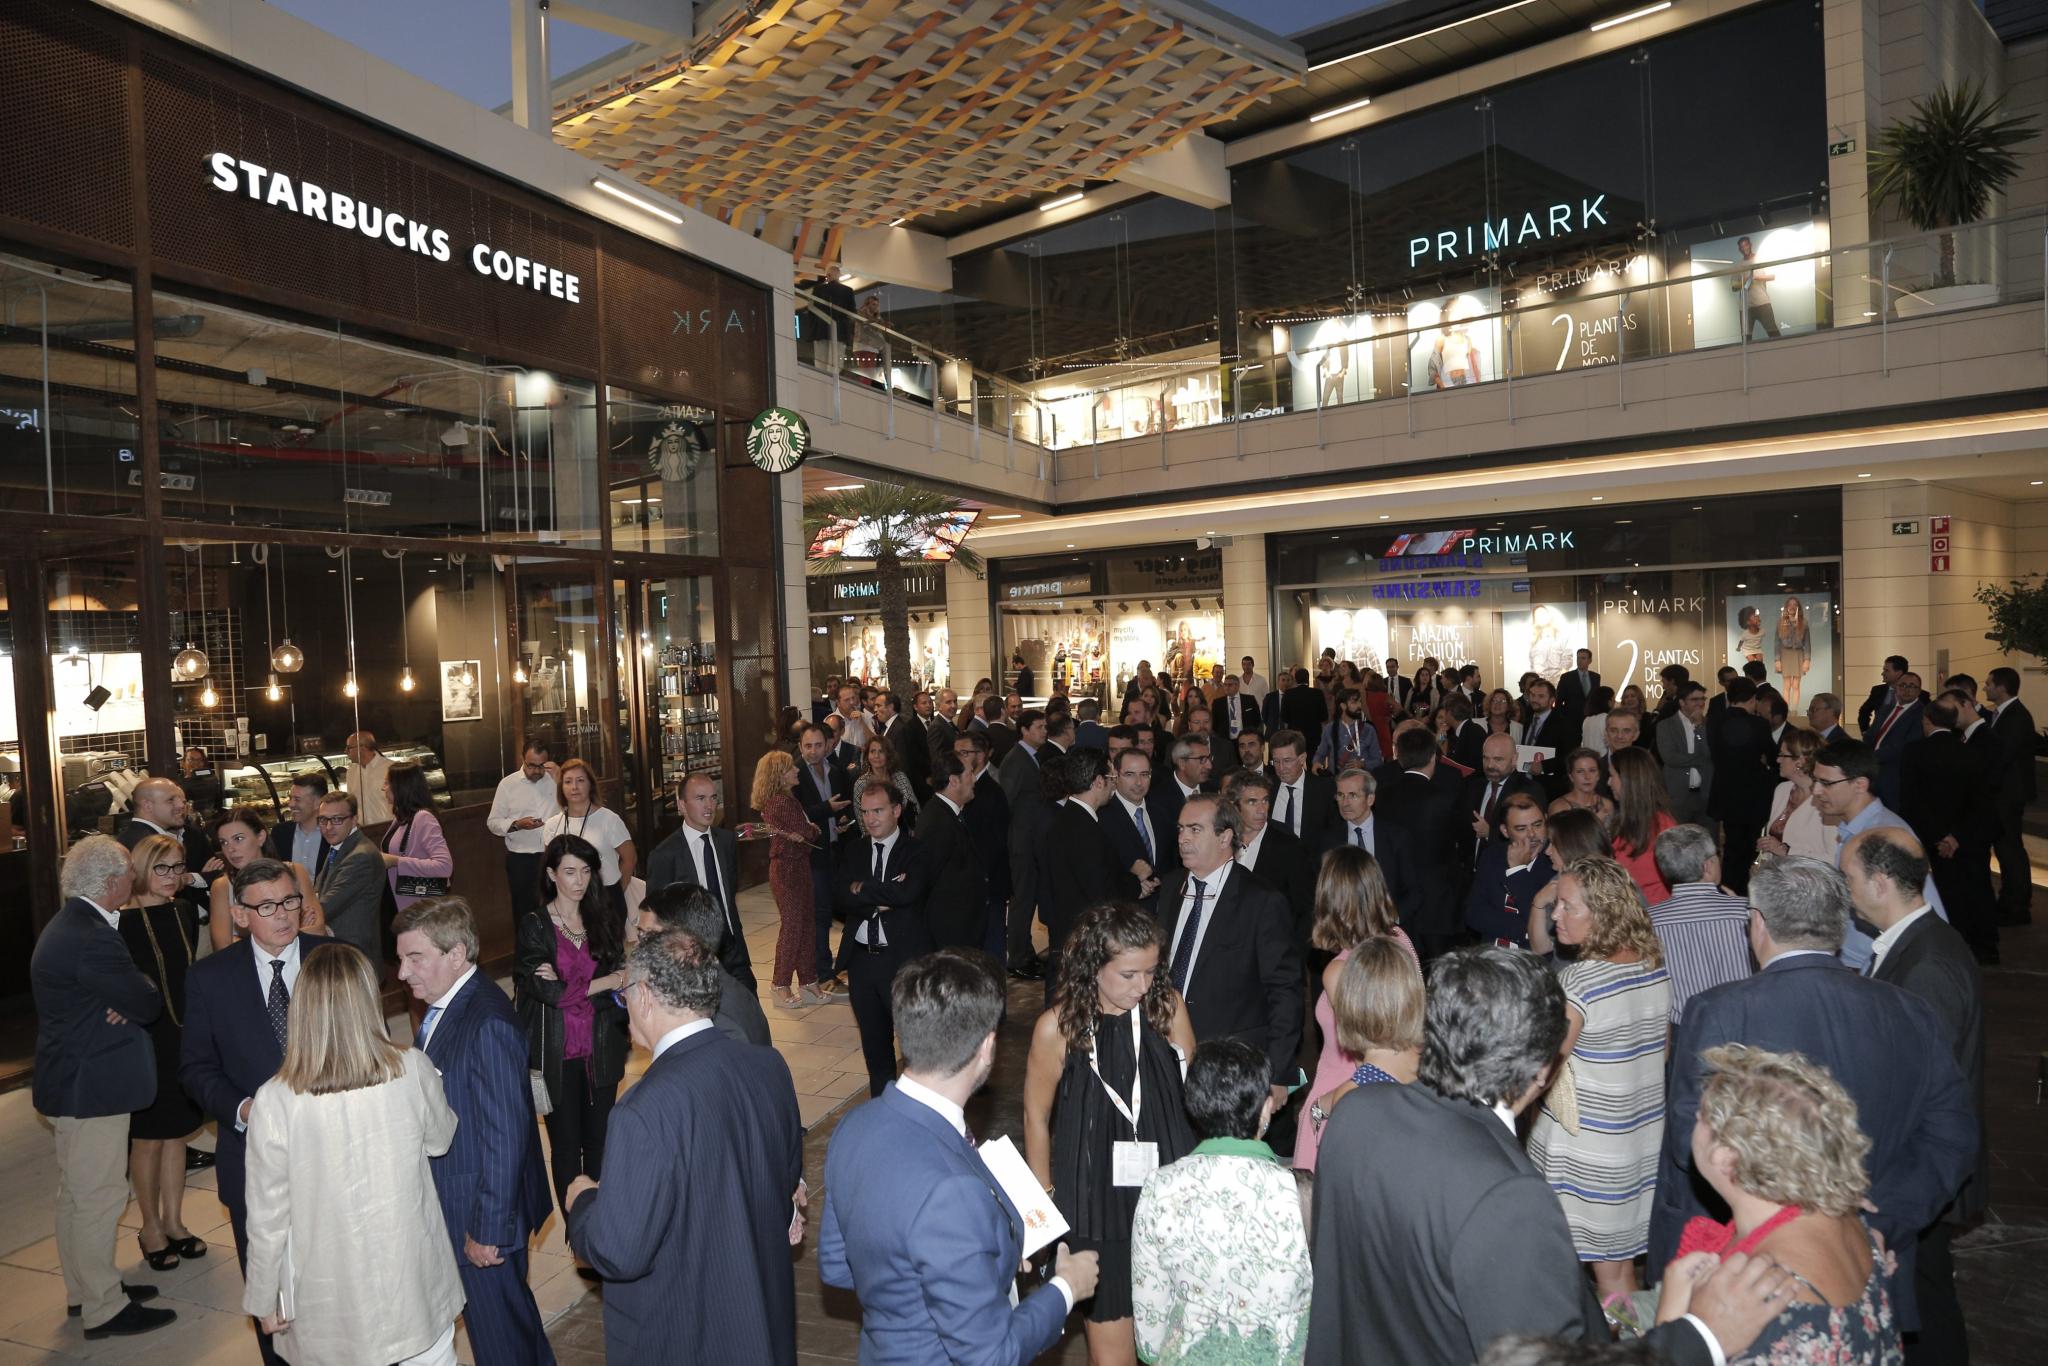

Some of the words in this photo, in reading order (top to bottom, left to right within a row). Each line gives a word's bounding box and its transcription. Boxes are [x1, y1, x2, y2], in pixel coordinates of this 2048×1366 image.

[210, 152, 451, 262] STARBUCKS
[471, 243, 580, 304] COFFEE
[1409, 194, 1607, 268] PRIMARK
[1536, 256, 1638, 291] PRIMARK
[1579, 313, 1637, 338] PLANTAS
[1580, 339, 1598, 357] DE
[1463, 530, 1575, 556] PRIMARK
[1603, 597, 1703, 615] PRIMARK
[1411, 622, 1461, 644] AMAZING
[1644, 649, 1700, 665] PLANTAS
[1644, 667, 1661, 682] DE
[1645, 683, 1665, 699] MO
